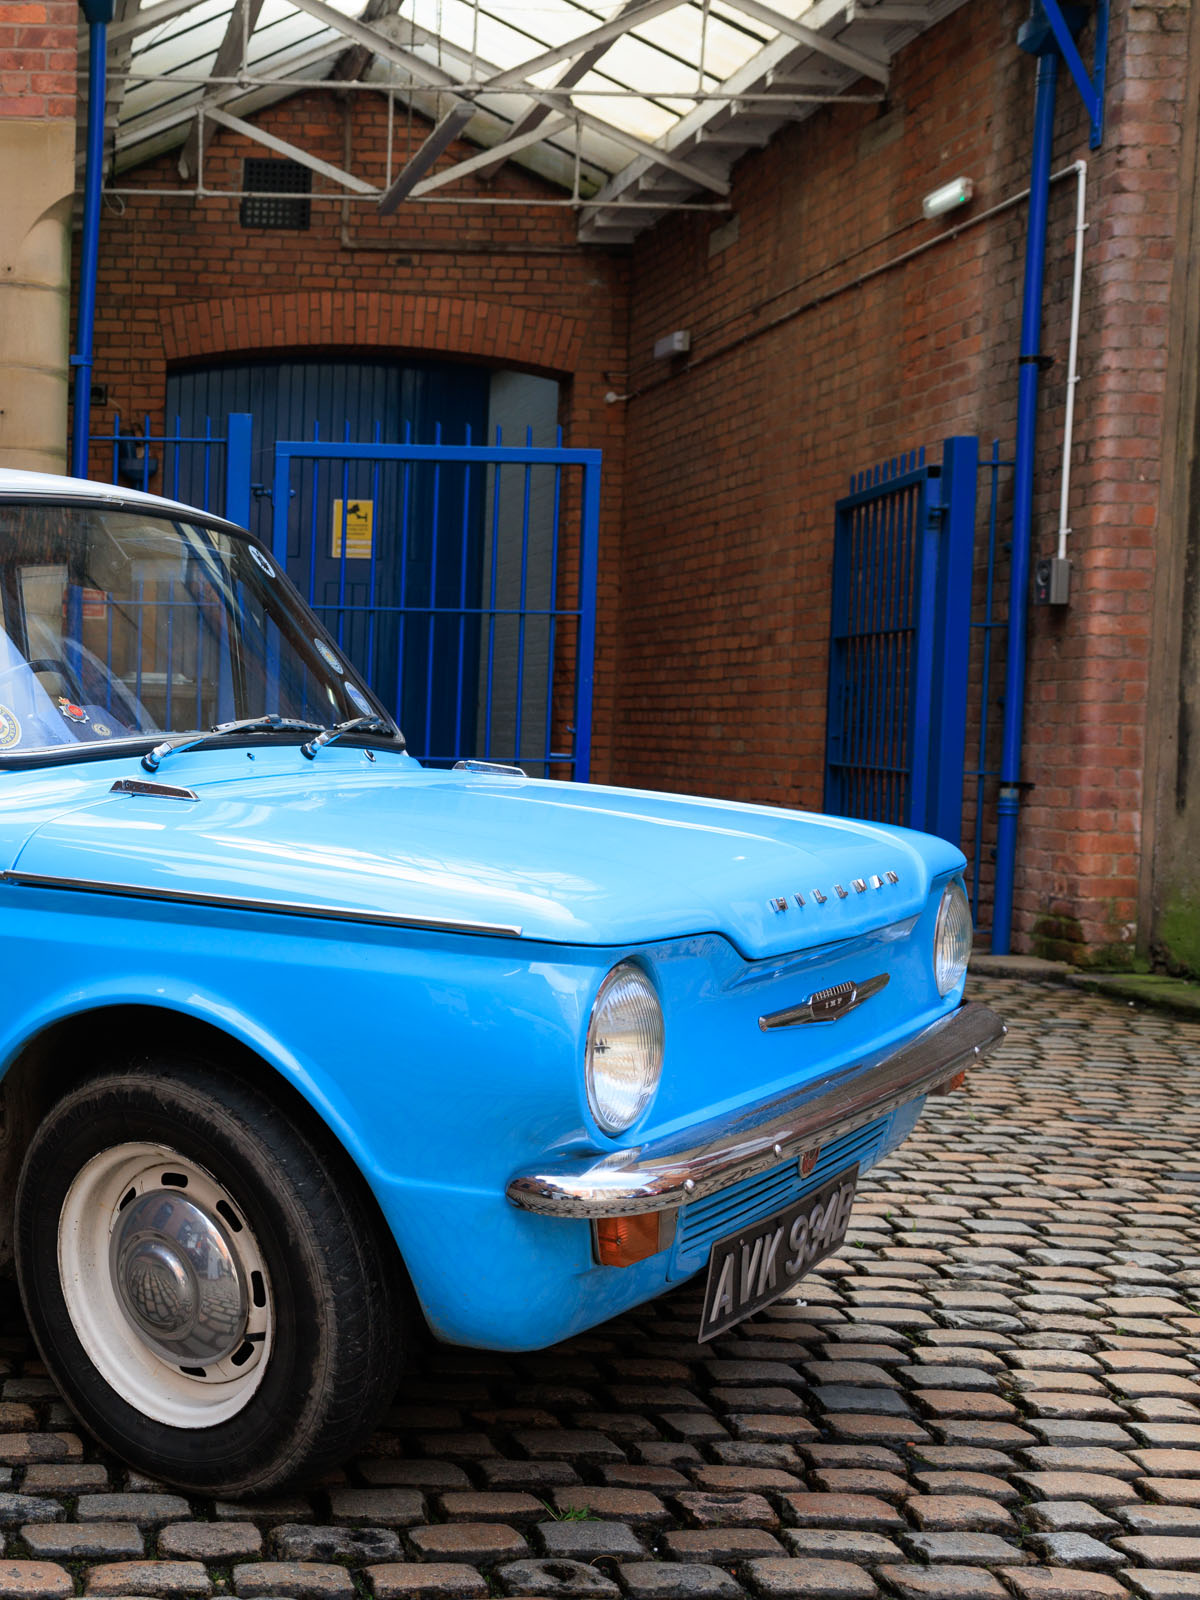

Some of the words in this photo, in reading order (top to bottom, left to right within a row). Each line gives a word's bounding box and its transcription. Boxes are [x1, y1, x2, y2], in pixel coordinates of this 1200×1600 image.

[770, 870, 899, 913] HILLMAN
[825, 998, 843, 1009] IMP
[709, 1226, 785, 1324] AVK
[786, 1182, 855, 1275] 934B
